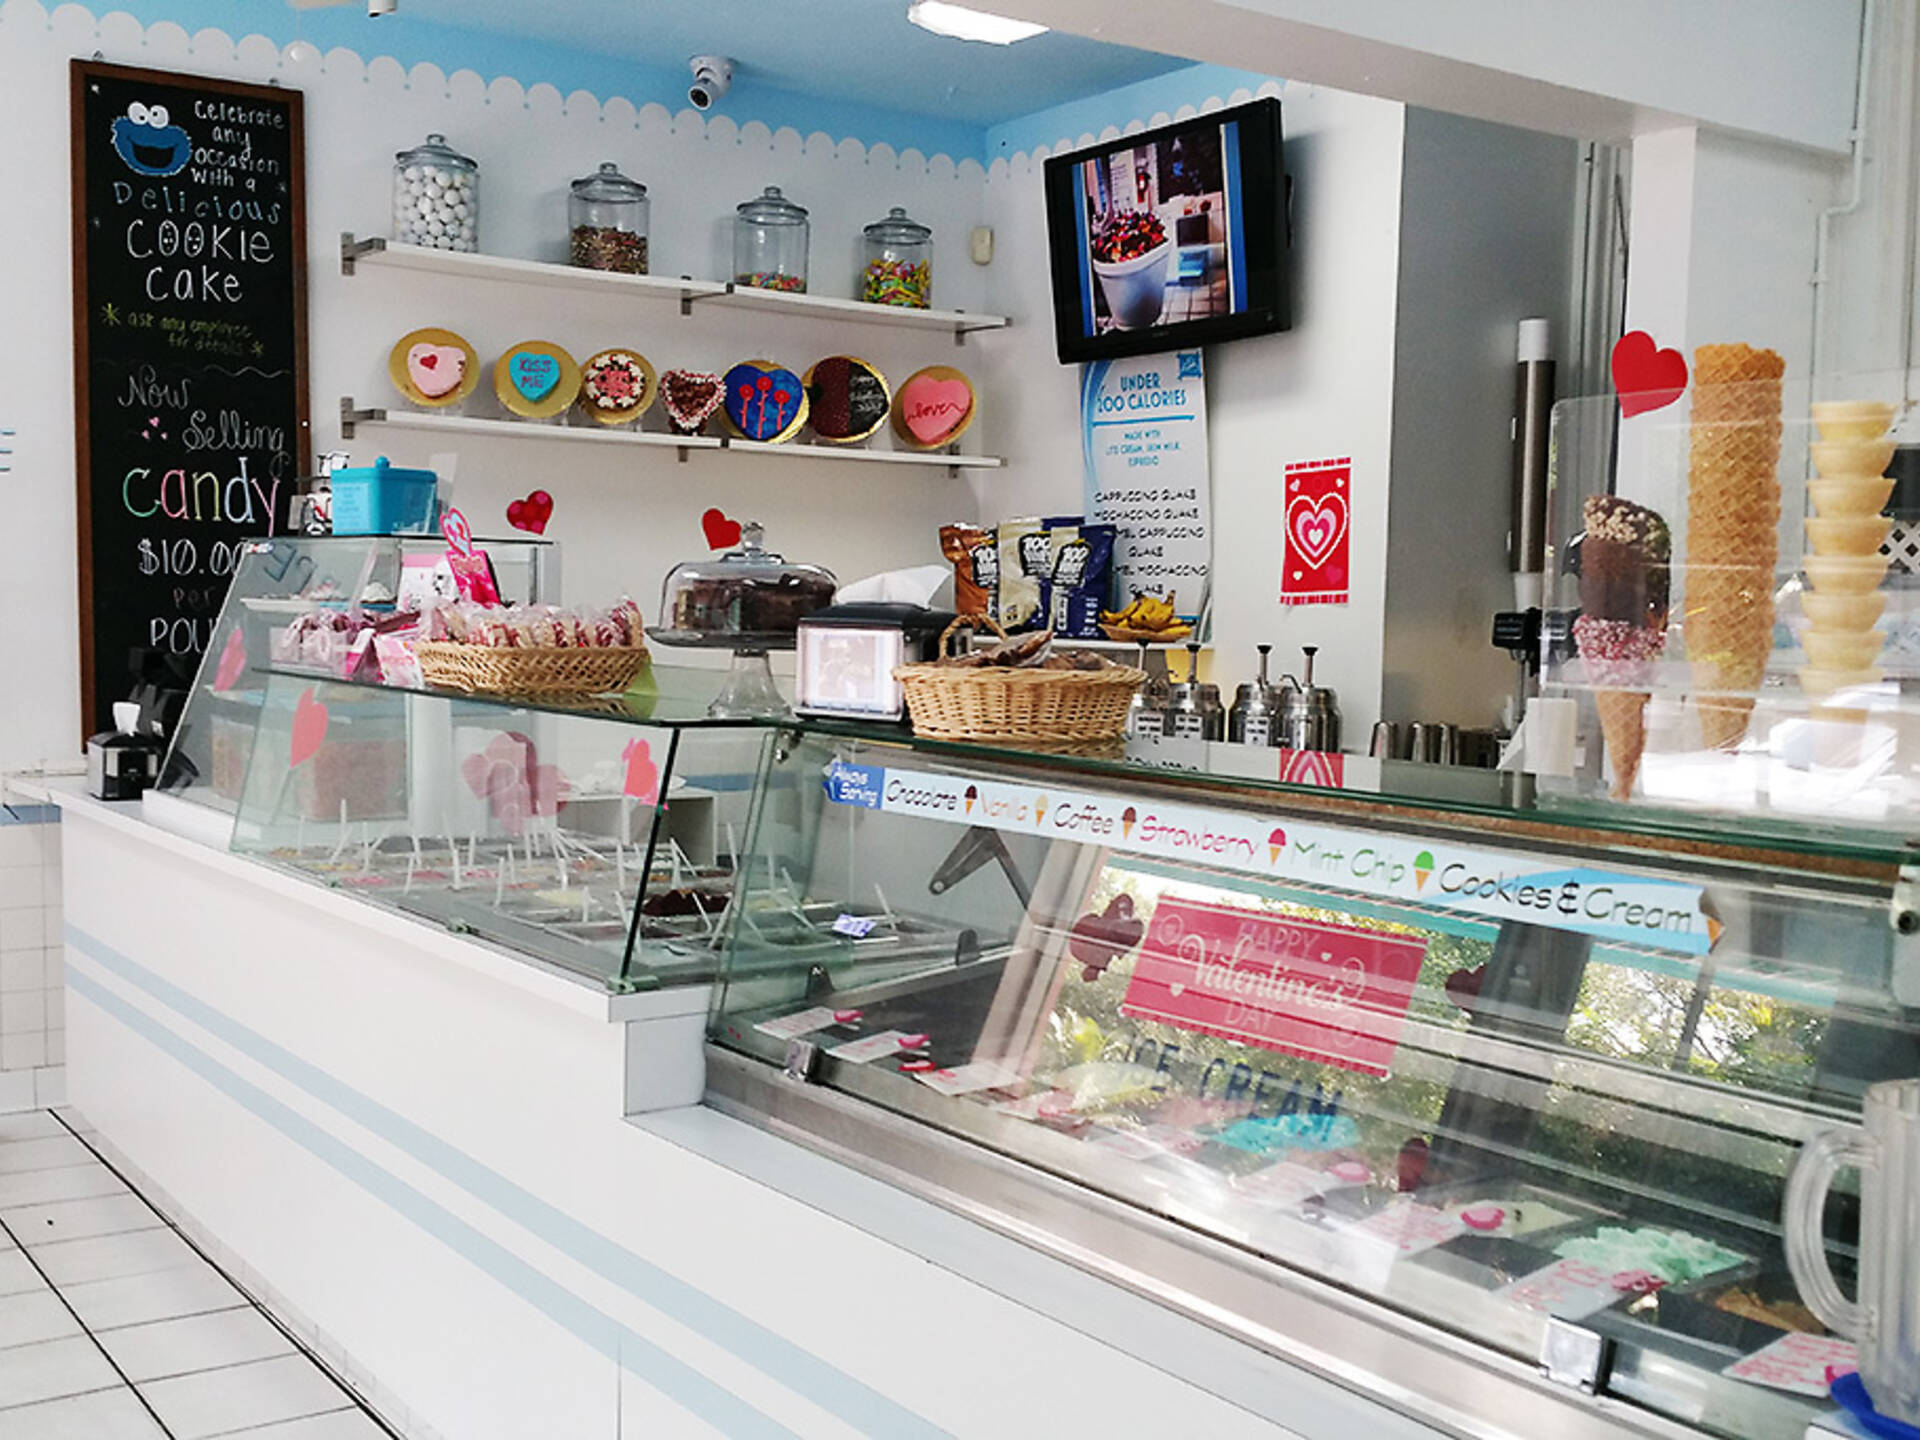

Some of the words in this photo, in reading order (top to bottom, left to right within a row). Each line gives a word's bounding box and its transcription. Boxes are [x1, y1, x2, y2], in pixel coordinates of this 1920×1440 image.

[212, 125, 252, 160] any
[245, 178, 256, 191] a
[113, 181, 281, 225] Delicious
[519, 357, 552, 373] KISS
[521, 374, 544, 388] ME
[117, 364, 192, 410] Now
[1120, 372, 1160, 392] UNDER
[1127, 389, 1186, 410] CALORIES
[181, 409, 291, 478] Selling
[839, 781, 878, 807] Serving
[887, 779, 958, 811] Chocolate
[980, 791, 1028, 823] Vanilla
[1053, 802, 1114, 835] Coffee
[1140, 814, 1259, 862] Strawberry
[1290, 839, 1344, 872] Mint
[1350, 848, 1406, 890] Chip
[1440, 863, 1552, 911] Cookies
[1557, 877, 1581, 917] &
[1584, 887, 1693, 934] Cream
[1237, 920, 1320, 958] HAPPY
[1225, 999, 1273, 1031] DAY
